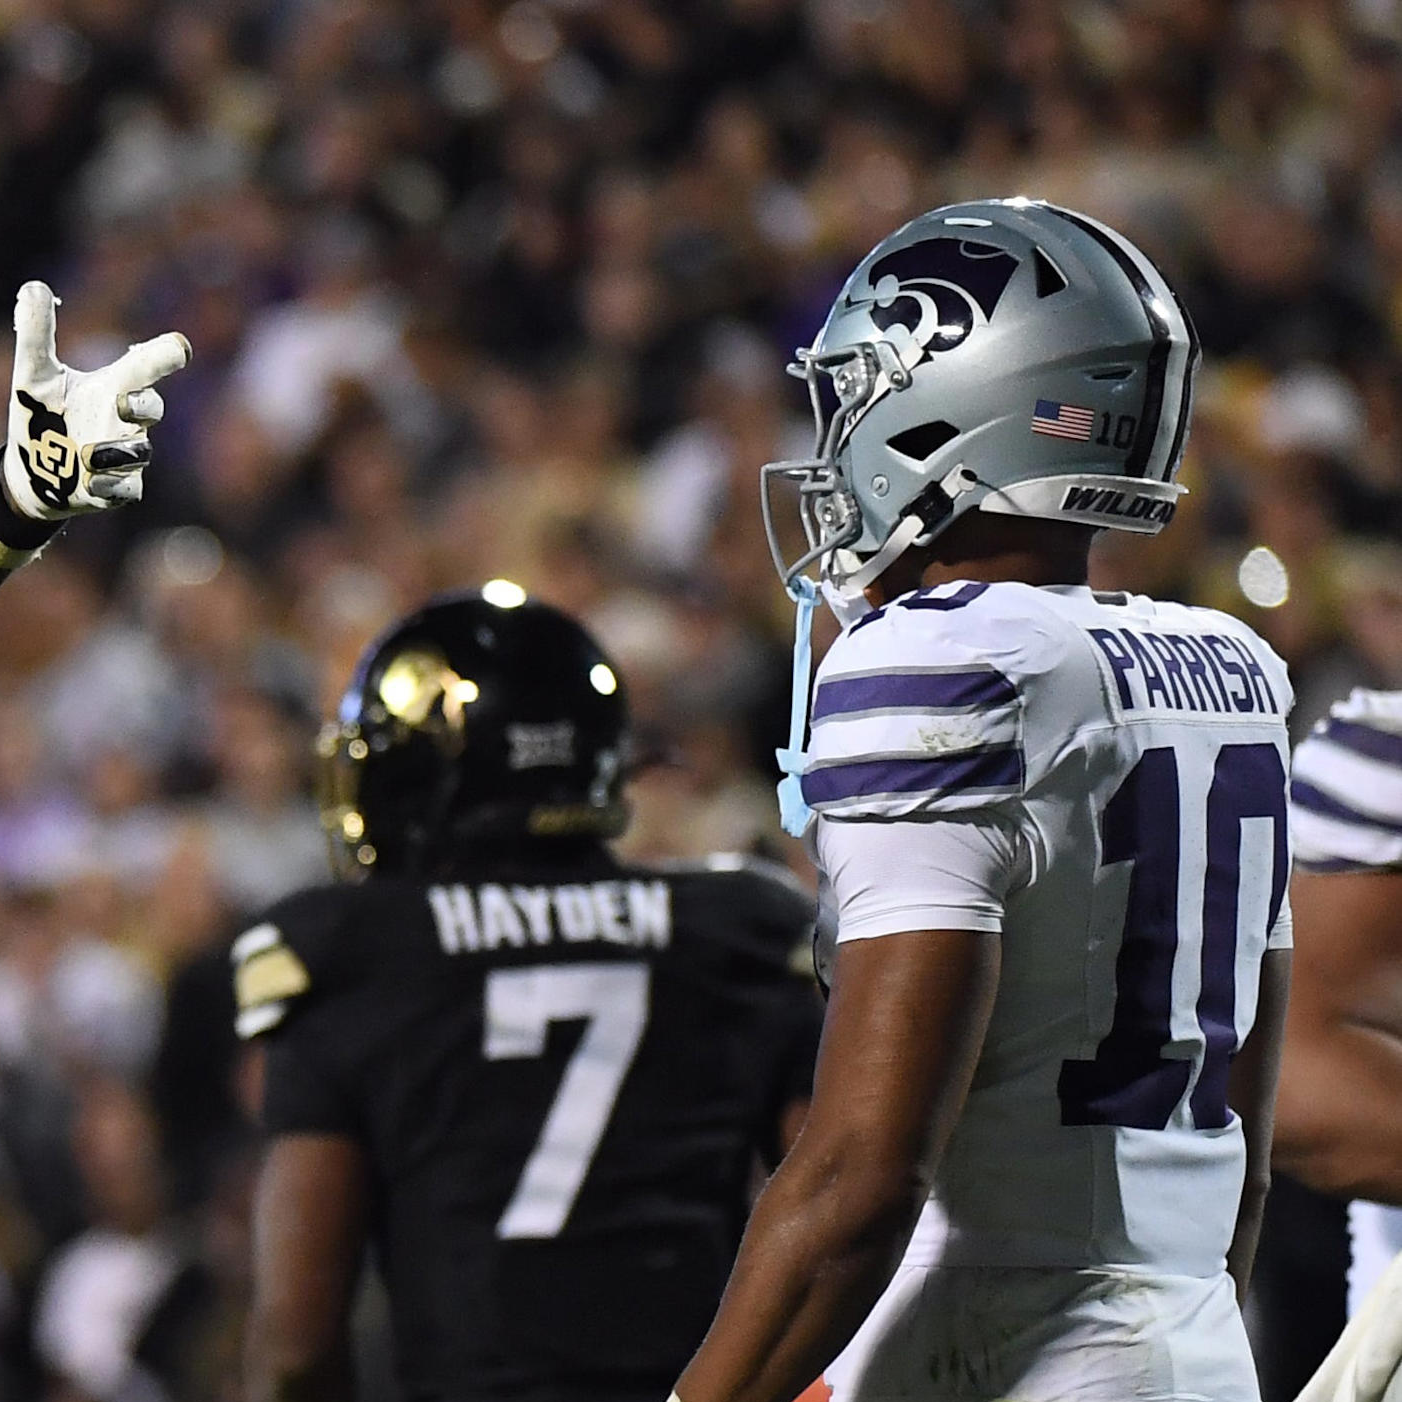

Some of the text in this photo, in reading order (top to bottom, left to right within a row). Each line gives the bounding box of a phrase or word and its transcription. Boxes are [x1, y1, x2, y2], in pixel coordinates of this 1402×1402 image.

[1096, 410, 1137, 450] 10
[1085, 627, 1279, 715] PARRISH
[428, 880, 672, 956] HAYDEN
[1057, 743, 1290, 1130] 10
[483, 961, 651, 1239] 7
